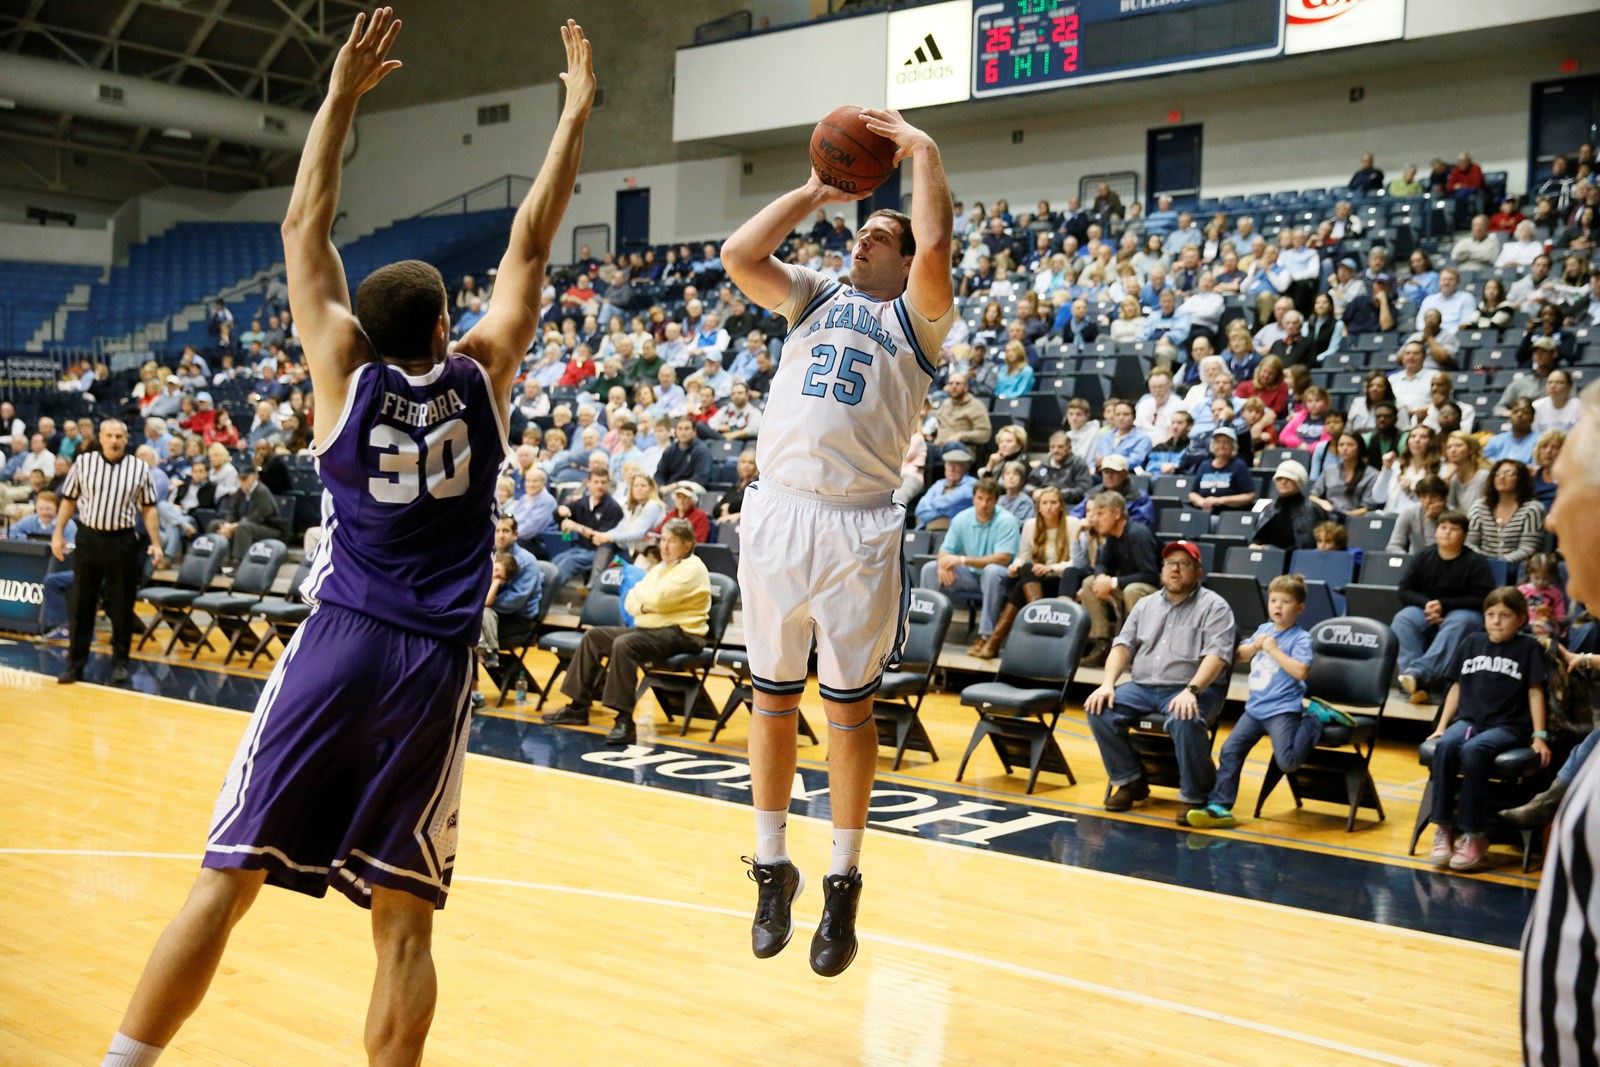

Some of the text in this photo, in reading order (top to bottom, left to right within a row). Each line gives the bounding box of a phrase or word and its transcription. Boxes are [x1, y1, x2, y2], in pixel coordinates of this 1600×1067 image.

[985, 26, 1012, 53] 25
[1052, 15, 1079, 42] 22
[985, 59, 998, 83] 6
[1014, 53, 1032, 79] 14
[1044, 51, 1049, 74] 1
[1064, 46, 1079, 72] 2
[896, 65, 954, 84] adidas
[819, 137, 857, 167] NCAA
[803, 303, 897, 357] TADEL
[802, 344, 873, 406] 25
[381, 388, 467, 427] FERRARA
[368, 418, 472, 504] 30
[1024, 605, 1071, 626] CITADEL
[1317, 625, 1379, 648] CITADEL
[1461, 655, 1522, 680] CITADEL
